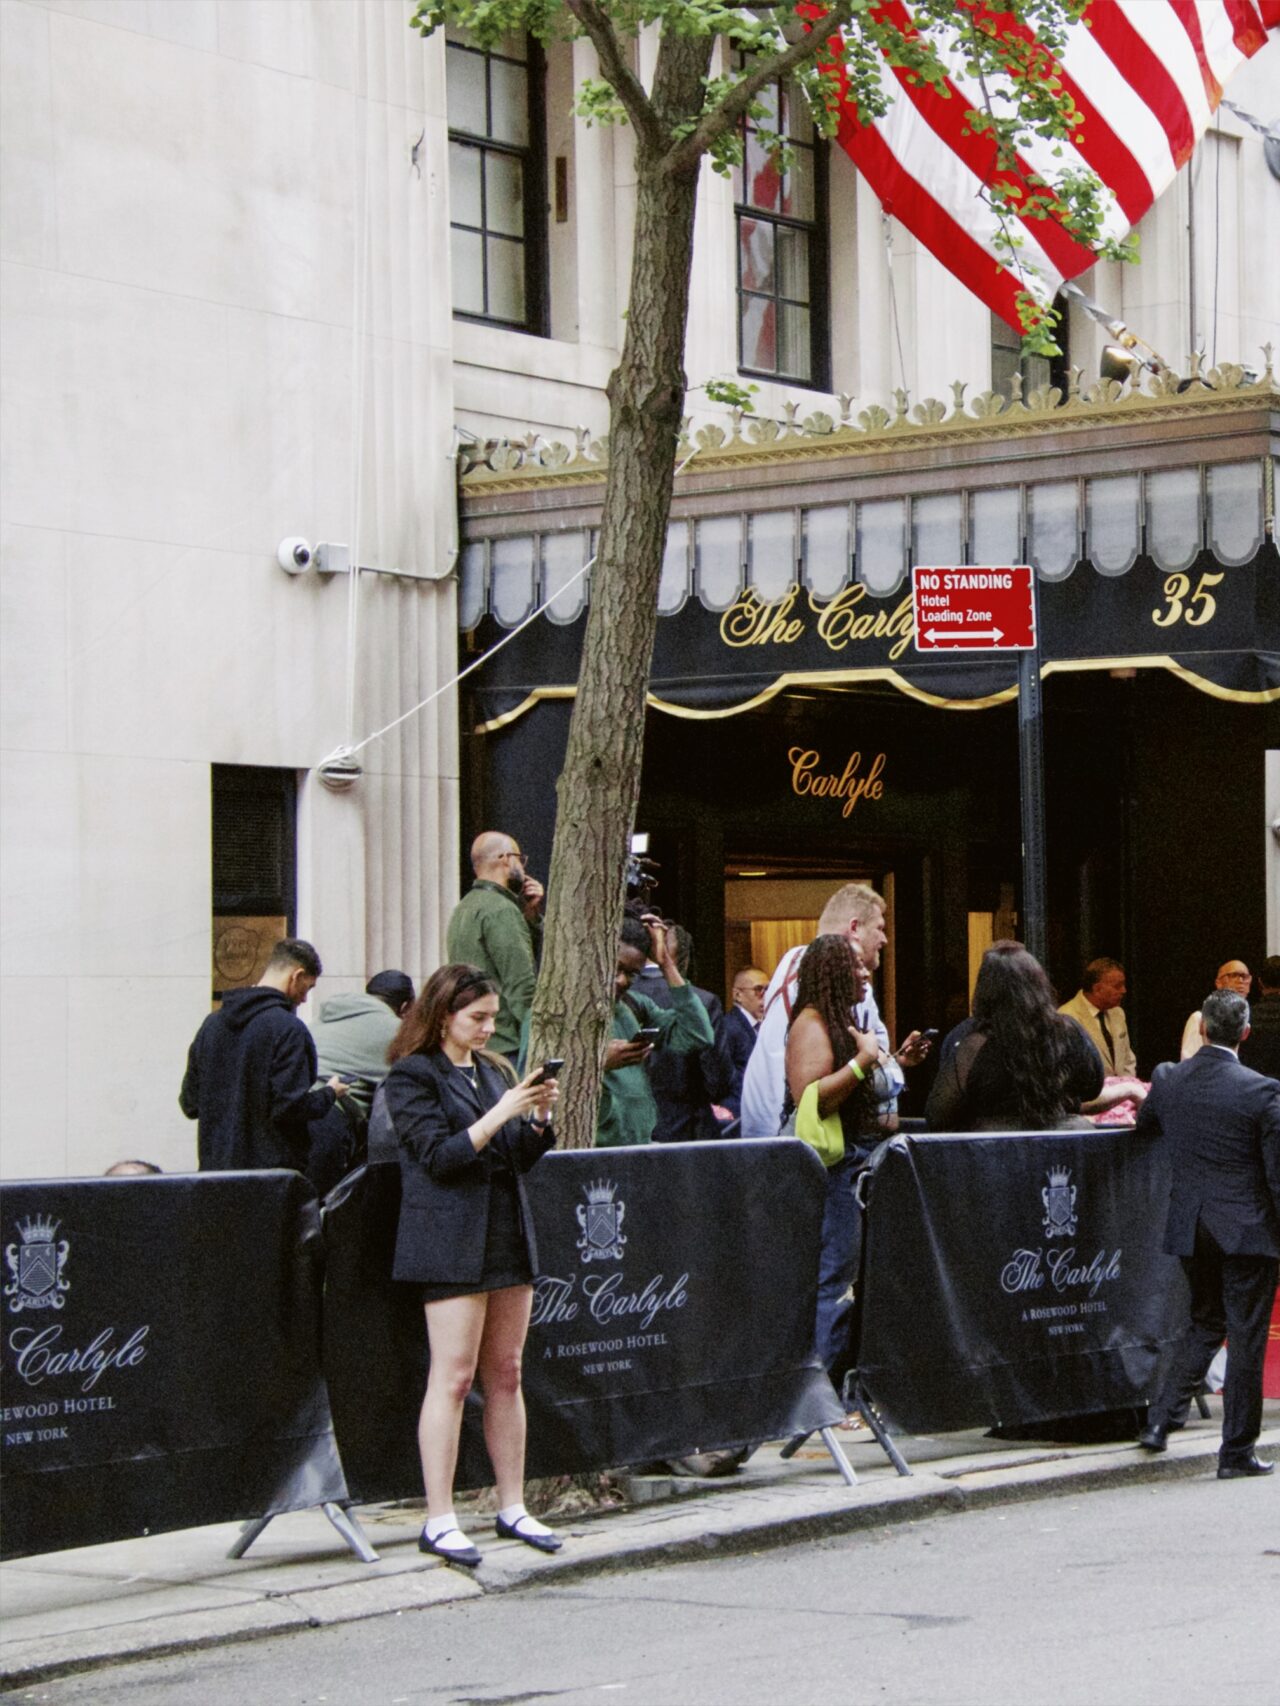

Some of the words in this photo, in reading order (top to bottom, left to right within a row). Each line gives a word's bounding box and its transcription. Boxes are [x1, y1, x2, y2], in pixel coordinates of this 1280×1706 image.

[920, 575, 941, 590] NO
[944, 574, 1013, 590] STANDING
[921, 594, 950, 607] Hotel
[1152, 572, 1225, 627] 35
[719, 583, 805, 648] The
[808, 582, 914, 660] Carly
[921, 609, 964, 625] Loading
[966, 609, 993, 622] Zone
[787, 747, 887, 818] Carlyle
[1001, 1247, 1045, 1293] The
[1047, 1247, 1122, 1297] Carlyle
[528, 1272, 580, 1327] The
[582, 1272, 690, 1331] Carlyle
[1021, 1310, 1028, 1321] A
[1030, 1304, 1077, 1320] ROSEWOOD
[1080, 1301, 1107, 1314] HOTEL
[9, 1324, 150, 1392] Carlyle
[543, 1346, 552, 1359] A
[557, 1338, 623, 1357] ROSEWOOD
[627, 1332, 668, 1349] HOTEL
[583, 1363, 607, 1376] NEW
[607, 1359, 632, 1373] YORK
[0, 1402, 59, 1422] EWOOD
[64, 1396, 117, 1414] HOTEL
[6, 1430, 34, 1446] NEW
[36, 1426, 69, 1442] YORK
